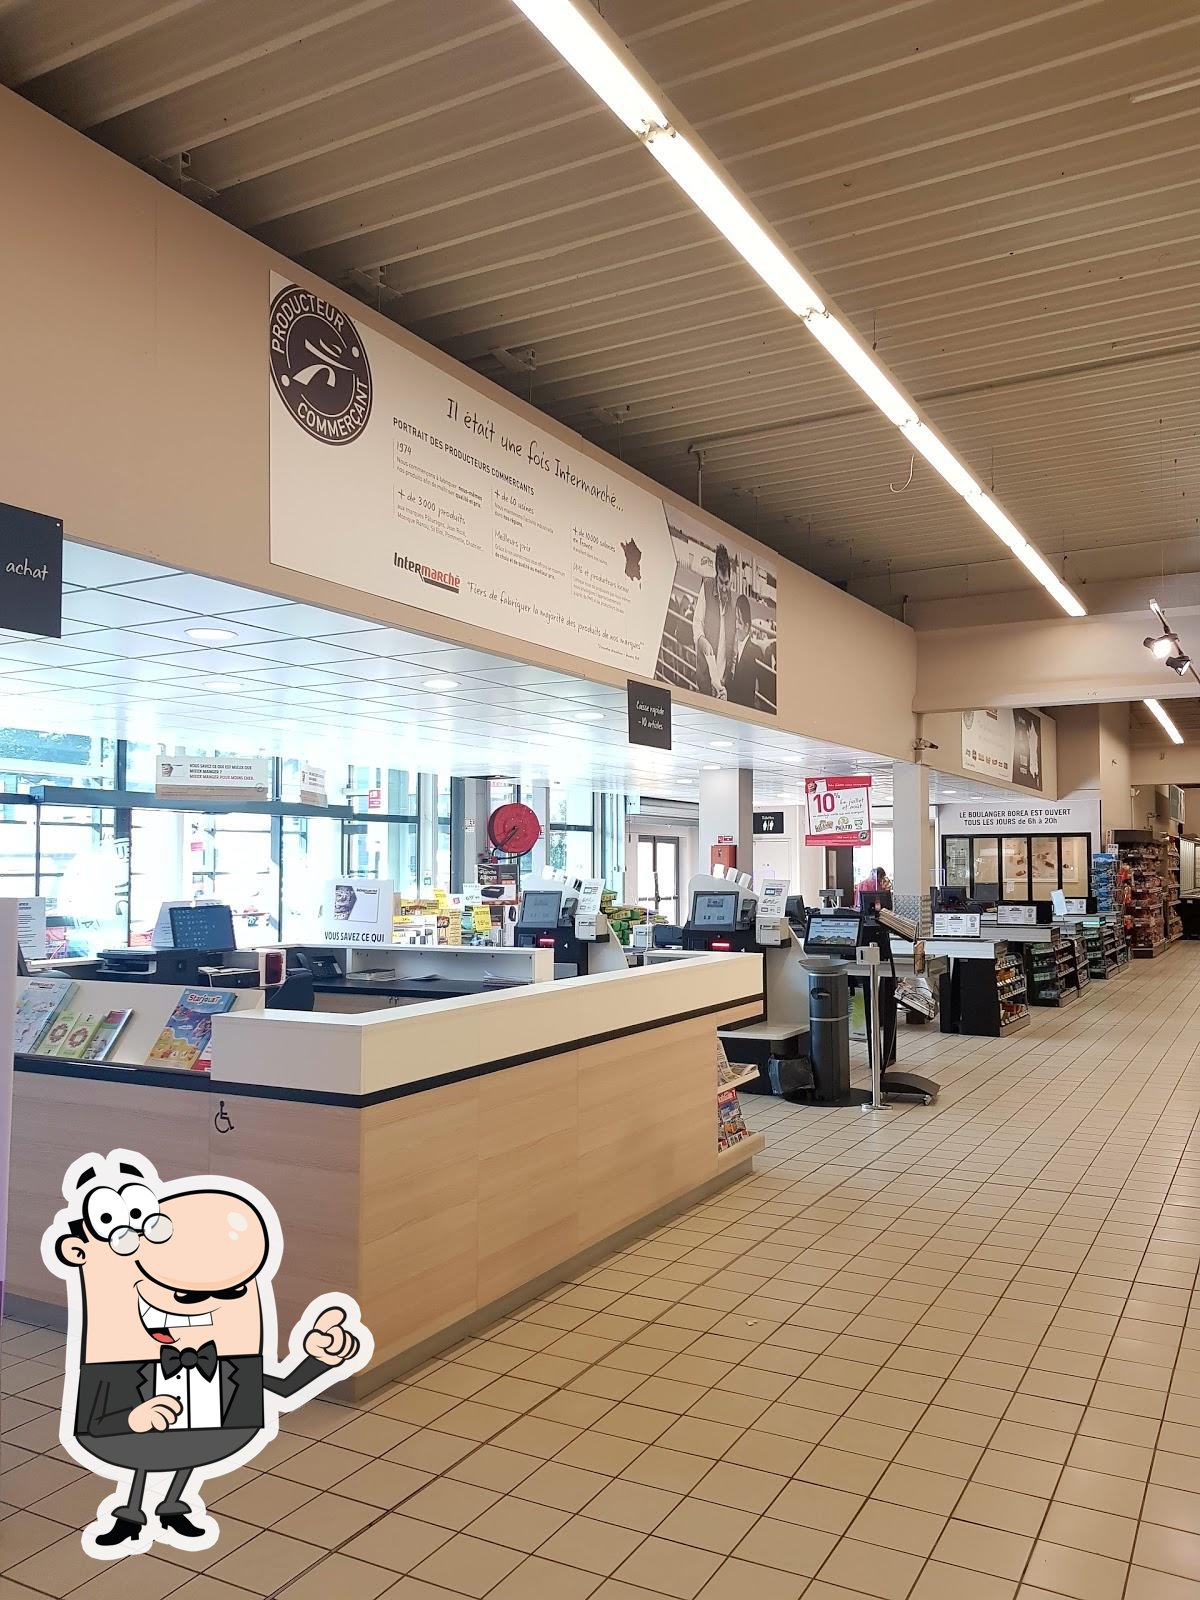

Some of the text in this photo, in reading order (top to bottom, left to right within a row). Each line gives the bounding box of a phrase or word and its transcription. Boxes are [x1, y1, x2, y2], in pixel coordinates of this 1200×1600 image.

[272, 292, 344, 353] PRODUCTEUR
[298, 378, 368, 438] COMMERÇANT
[393, 418, 428, 443] PORTRAIT
[430, 436, 443, 450] DES
[444, 444, 490, 474] PRODUCTEURS
[396, 442, 412, 456] 1974
[447, 398, 457, 421] Il
[464, 412, 495, 443] était
[501, 436, 522, 456] une
[527, 440, 550, 472] fois
[407, 492, 416, 502] de
[438, 508, 466, 524] produits
[6, 558, 49, 581] achat
[394, 552, 460, 588] Intermarché
[489, 590, 497, 601] de
[500, 590, 530, 613] fabriquer
[532, 604, 538, 614] la
[566, 616, 576, 628] des
[325, 932, 384, 942] VOUS SAVEZ CE QUI
